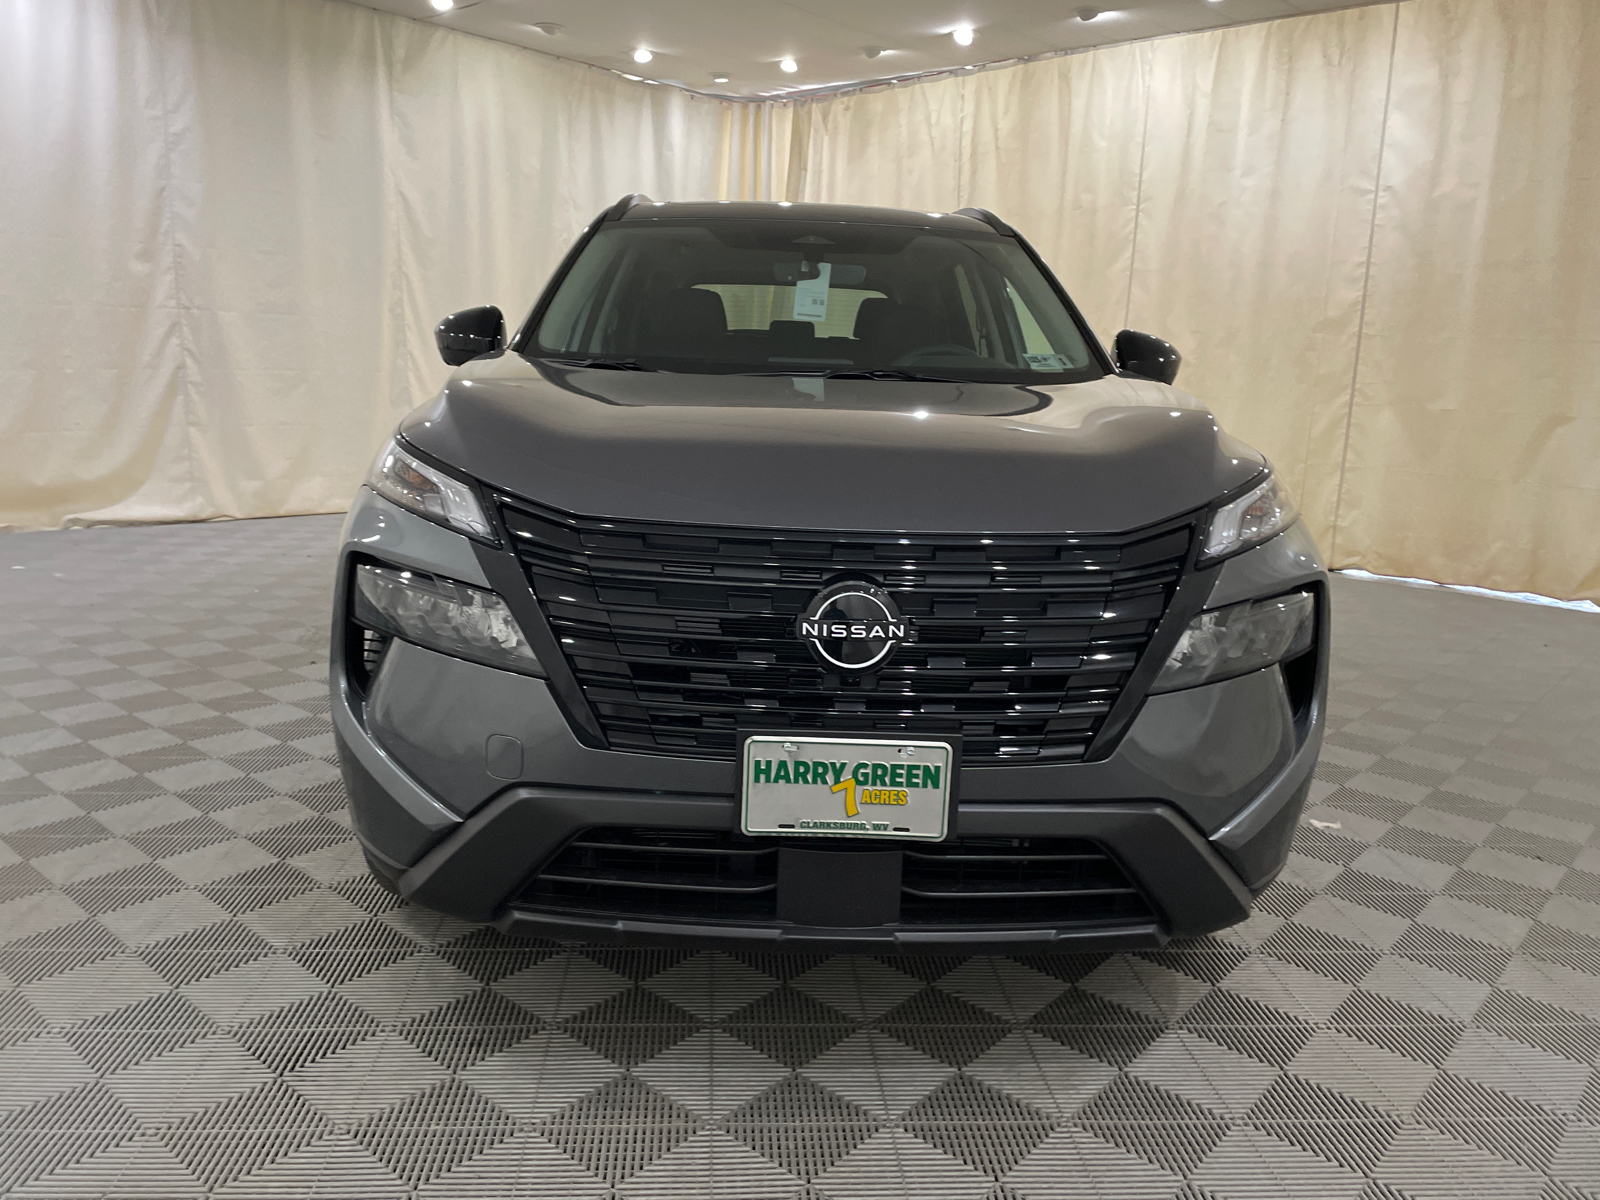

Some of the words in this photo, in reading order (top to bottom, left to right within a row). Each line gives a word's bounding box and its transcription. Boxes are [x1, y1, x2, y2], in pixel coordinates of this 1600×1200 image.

[802, 622, 904, 638] NISSAN
[753, 760, 847, 785] HARRY
[851, 762, 941, 789] GREEN
[830, 777, 860, 817] 7
[860, 790, 908, 805] ACRES
[872, 823, 889, 831] WV
